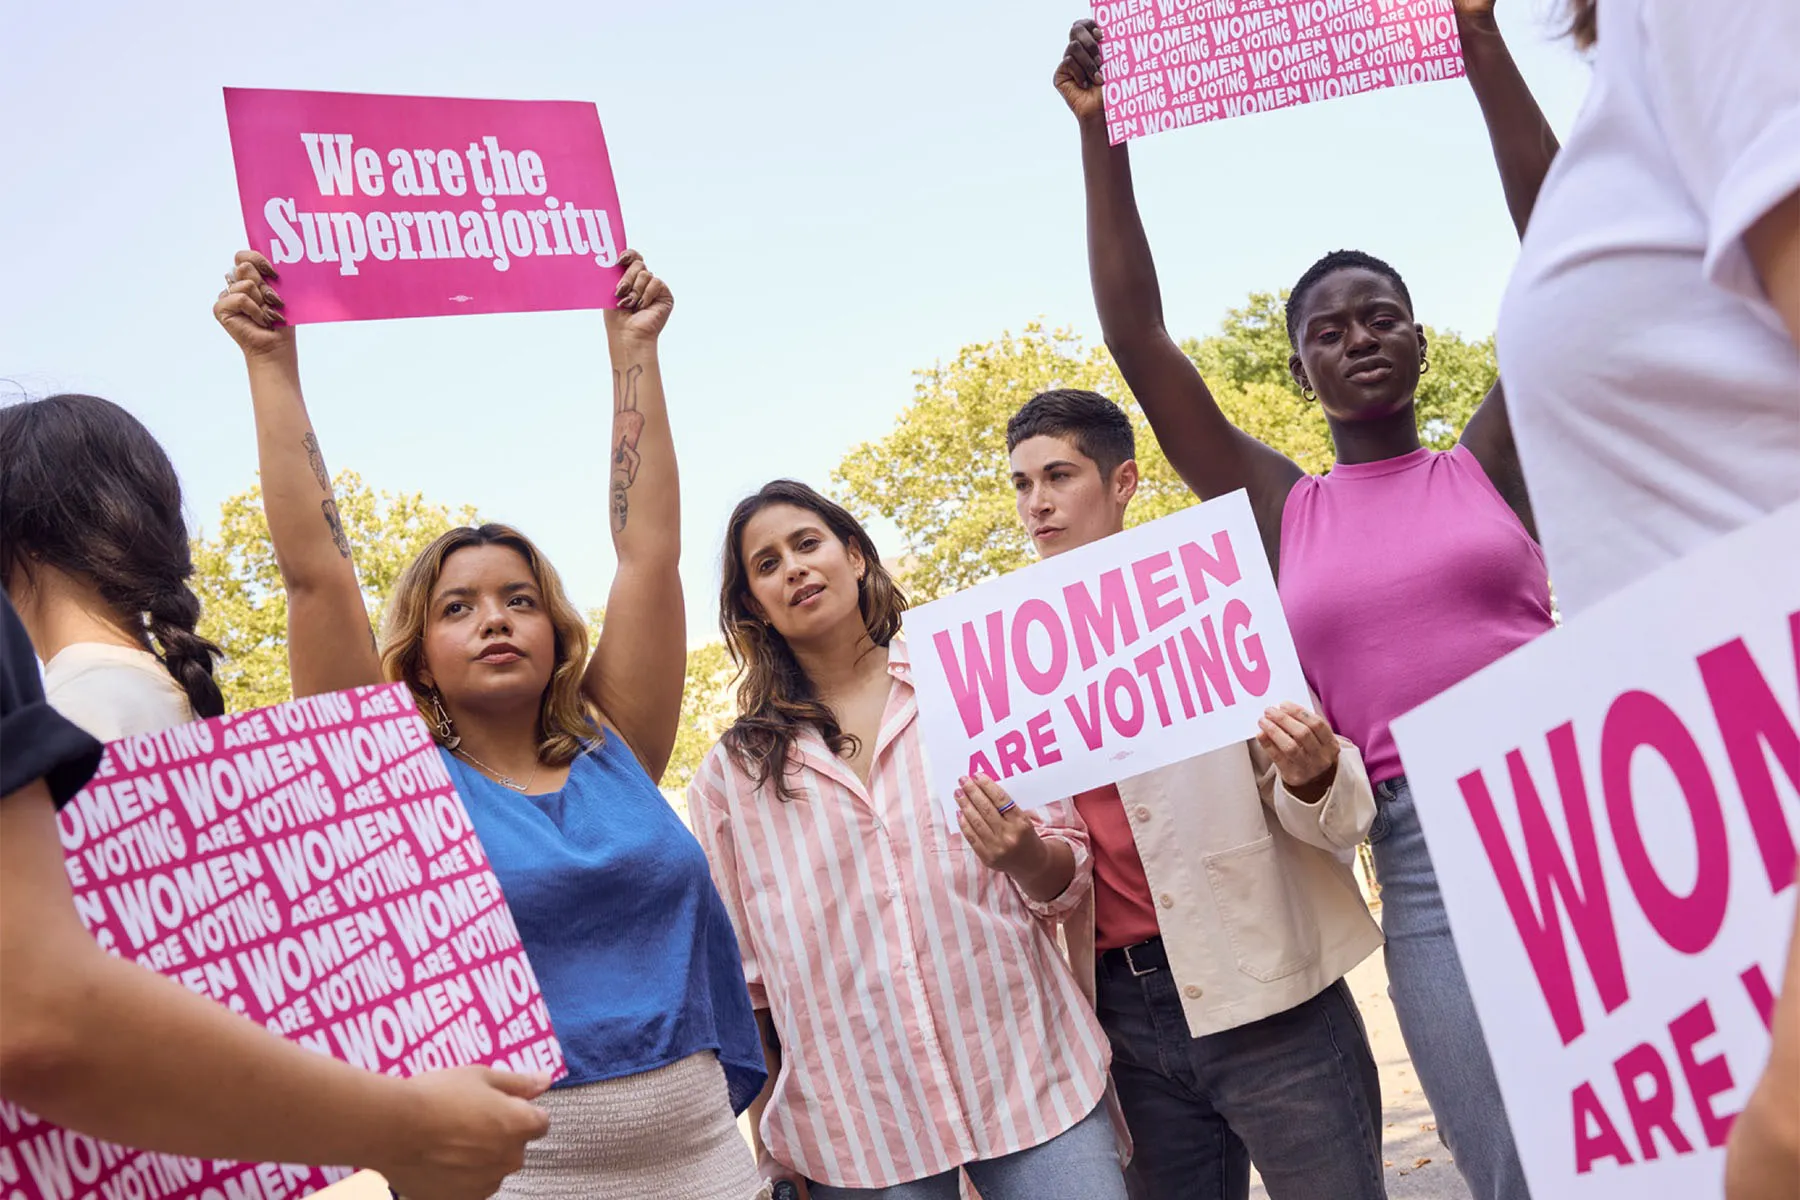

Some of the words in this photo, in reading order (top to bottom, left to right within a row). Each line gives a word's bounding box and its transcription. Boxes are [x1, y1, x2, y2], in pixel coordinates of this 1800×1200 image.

[1092, 0, 1153, 27] OMEN
[1107, 10, 1155, 38] VOTING
[1160, 13, 1185, 28] ARE
[1129, 22, 1206, 62] WOMEN
[1209, 7, 1288, 46] WOMEN
[1134, 57, 1159, 73] ARE
[1161, 37, 1210, 67] VOTING
[1214, 41, 1240, 57] ARE
[1241, 21, 1292, 51] VOTING
[1296, 25, 1322, 41] ARE
[1323, 4, 1375, 34] VOTING
[1379, 8, 1405, 24] ARE
[1101, 70, 1164, 108] OMEN
[1166, 54, 1245, 95] WOMEN
[1247, 38, 1328, 79] WOMEN
[1330, 22, 1412, 62] WOMEN
[1118, 86, 1167, 118] VOTING
[1171, 90, 1197, 106] ARE
[1198, 70, 1249, 100] VOTING
[1253, 73, 1279, 90] ARE
[1280, 53, 1332, 84] VOTING
[1336, 57, 1363, 74] ARE
[1364, 37, 1416, 68] VOTING
[1421, 42, 1448, 58] ARE
[1140, 100, 1219, 136] WOMEN
[1221, 85, 1302, 118] WOMEN
[1304, 68, 1387, 101] WOMEN
[300, 133, 384, 197] We
[386, 147, 467, 197] are
[465, 135, 548, 197] the
[263, 196, 618, 277] Supermajority
[932, 529, 1243, 740] WOMEN
[114, 720, 215, 773] VOTING
[223, 713, 272, 750] ARE
[266, 691, 354, 737] VOTING
[360, 687, 400, 719] ARE
[967, 709, 1064, 784] ARE
[1064, 598, 1272, 752] VOTING
[56, 773, 169, 851] OMEN
[167, 738, 318, 830] WOMEN
[83, 808, 187, 882] VOTING
[196, 815, 246, 855] ARE
[241, 769, 336, 839] VOTING
[343, 777, 387, 813] ARE
[104, 847, 264, 950] WOMEN
[262, 807, 404, 901] WOMEN
[182, 881, 283, 959] VOTING
[290, 885, 339, 927] ARE
[334, 838, 423, 908] VOTING
[428, 845, 470, 881] ARE
[235, 907, 388, 1014] WOMEN
[310, 940, 406, 1019] VOTING
[413, 944, 457, 985] ARE
[331, 973, 475, 1074] WOMEN
[404, 1007, 493, 1077] VOTING
[499, 1011, 536, 1050] ARE
[1570, 998, 1740, 1176] ARE
